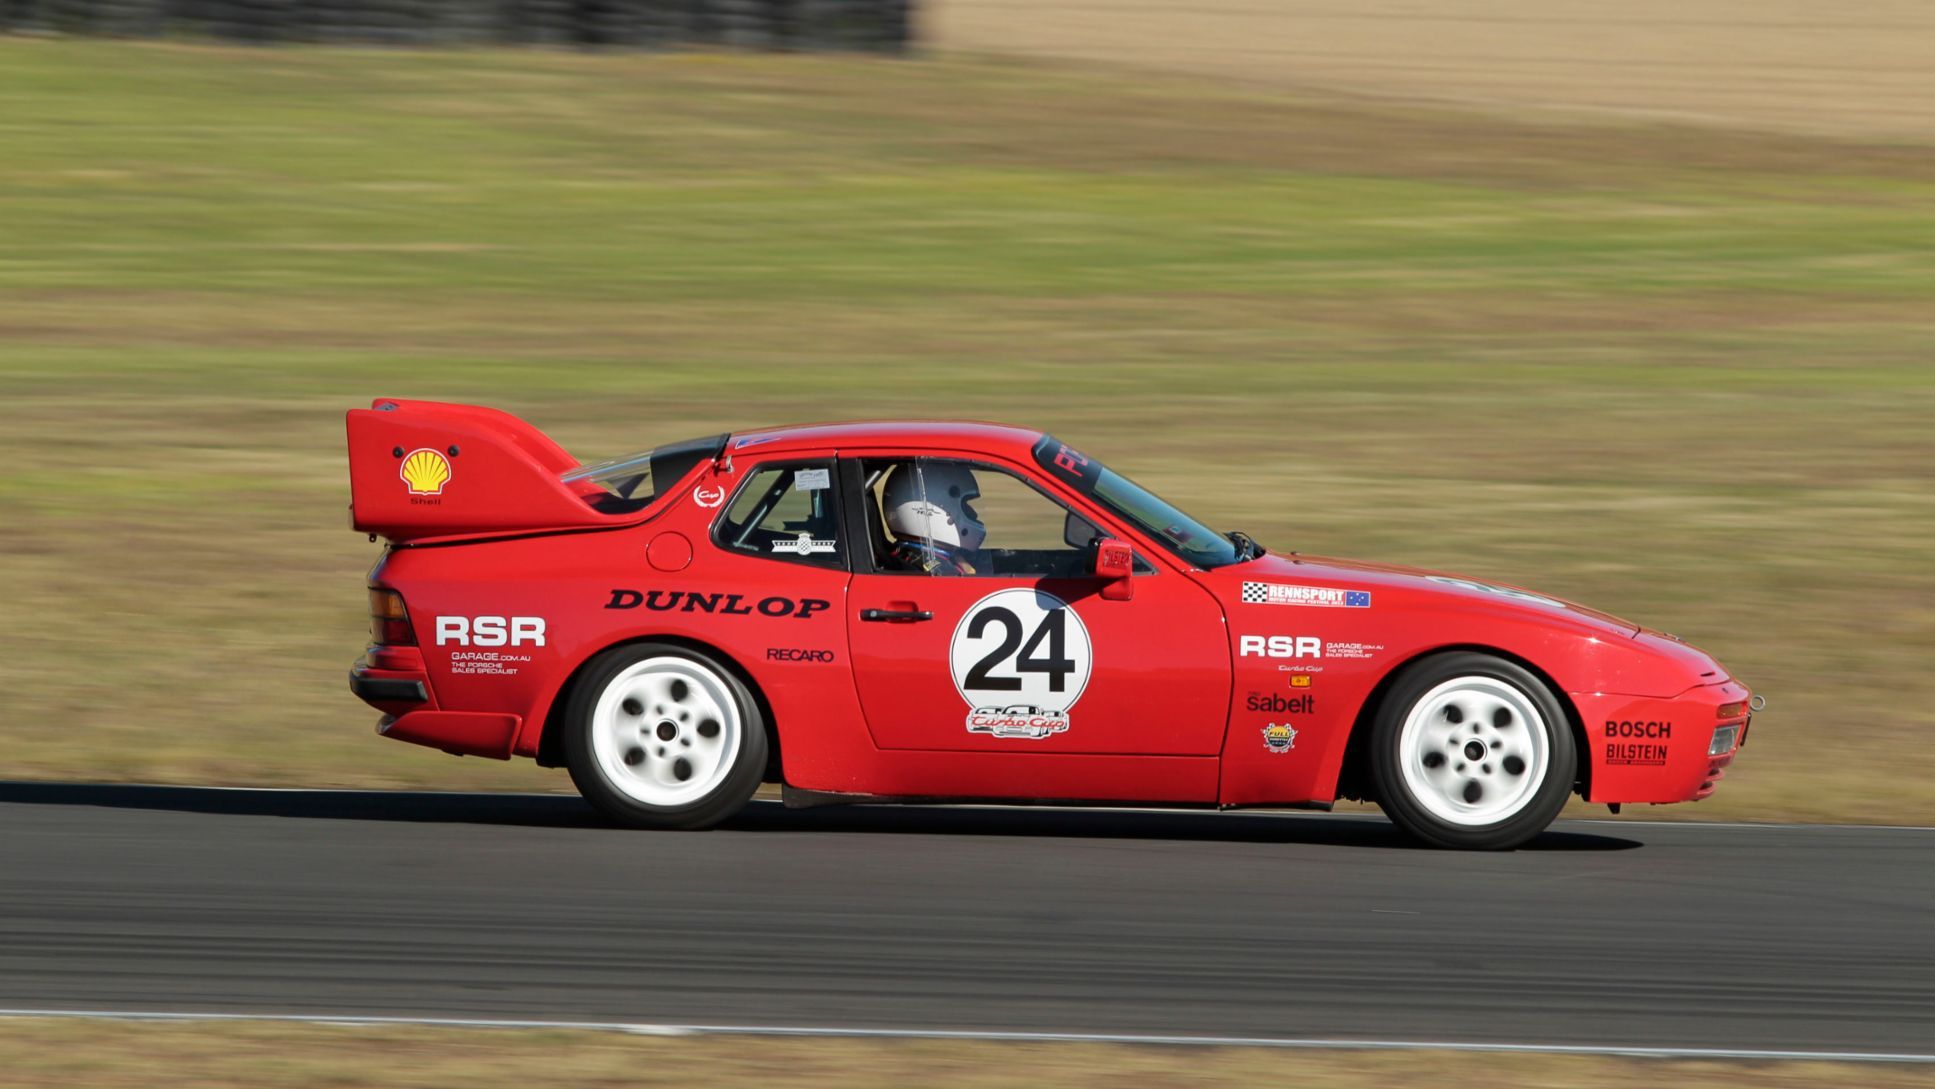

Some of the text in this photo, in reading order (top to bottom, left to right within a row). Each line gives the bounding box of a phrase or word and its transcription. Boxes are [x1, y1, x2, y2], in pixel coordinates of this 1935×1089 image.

[1269, 585, 1344, 601] RENNSPORT
[604, 589, 831, 619] DUNLOP
[436, 615, 546, 647] RSR
[767, 648, 834, 663] RECARO
[964, 606, 1075, 692] 24
[1240, 635, 1321, 658] RSR
[1247, 693, 1314, 714] sabelt
[1029, 717, 1065, 729] Cup
[1605, 721, 1671, 738] BOSCH
[1606, 744, 1667, 759] BILSTEIN
